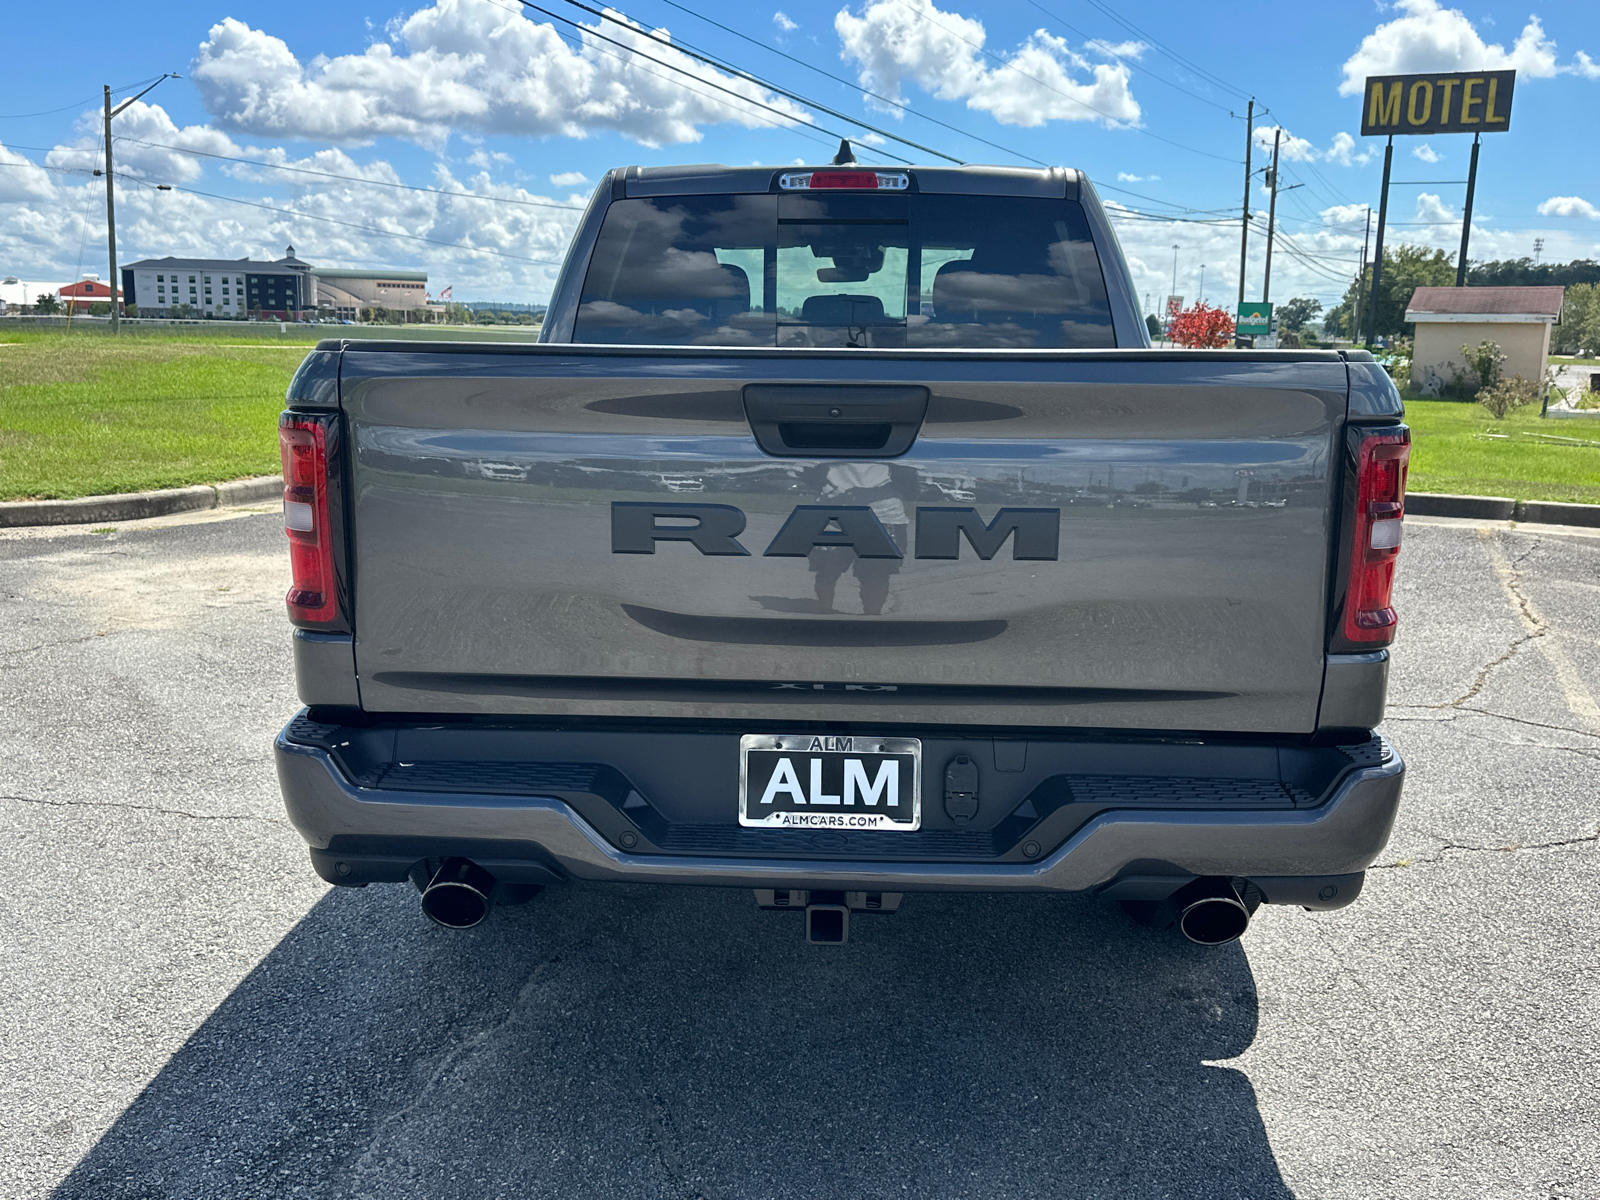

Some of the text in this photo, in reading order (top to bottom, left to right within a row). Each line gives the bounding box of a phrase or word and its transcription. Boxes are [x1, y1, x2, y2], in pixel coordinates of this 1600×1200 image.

[1368, 77, 1506, 127] MOTEL
[611, 501, 1060, 560] RAM
[808, 736, 854, 752] ALM
[760, 757, 899, 807] ALM
[782, 814, 878, 827] ALMCARS.COM
